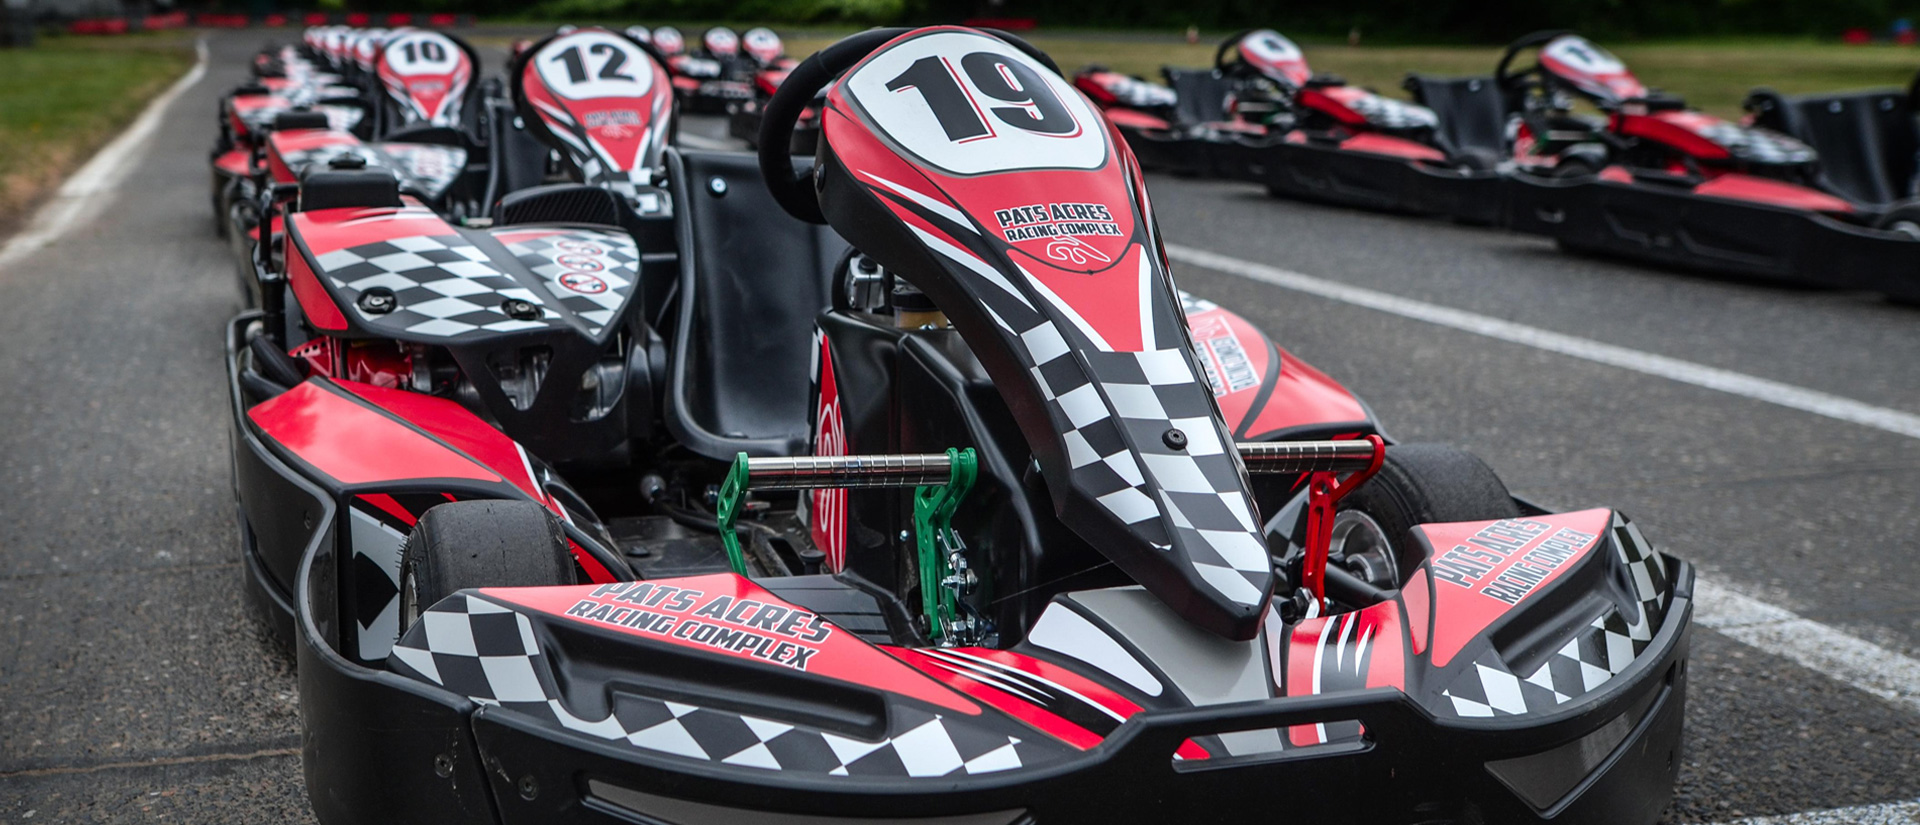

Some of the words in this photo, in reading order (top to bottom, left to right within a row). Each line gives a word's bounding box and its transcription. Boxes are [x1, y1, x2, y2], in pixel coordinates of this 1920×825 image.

[401, 41, 446, 63] 10
[551, 43, 635, 84] 12
[885, 52, 1082, 144] 19
[994, 204, 1050, 229] PATS
[1049, 203, 1113, 222] ACRES
[1003, 223, 1059, 243] RACING
[1056, 222, 1124, 236] COMPLEX
[1432, 545, 1504, 589] PATS
[1480, 560, 1552, 606] RACING
[1521, 527, 1598, 572] COMPLEX
[590, 582, 703, 612] PATS
[692, 595, 833, 643] ACRES
[565, 600, 677, 636] RACING
[672, 619, 819, 671] COMPLEX
